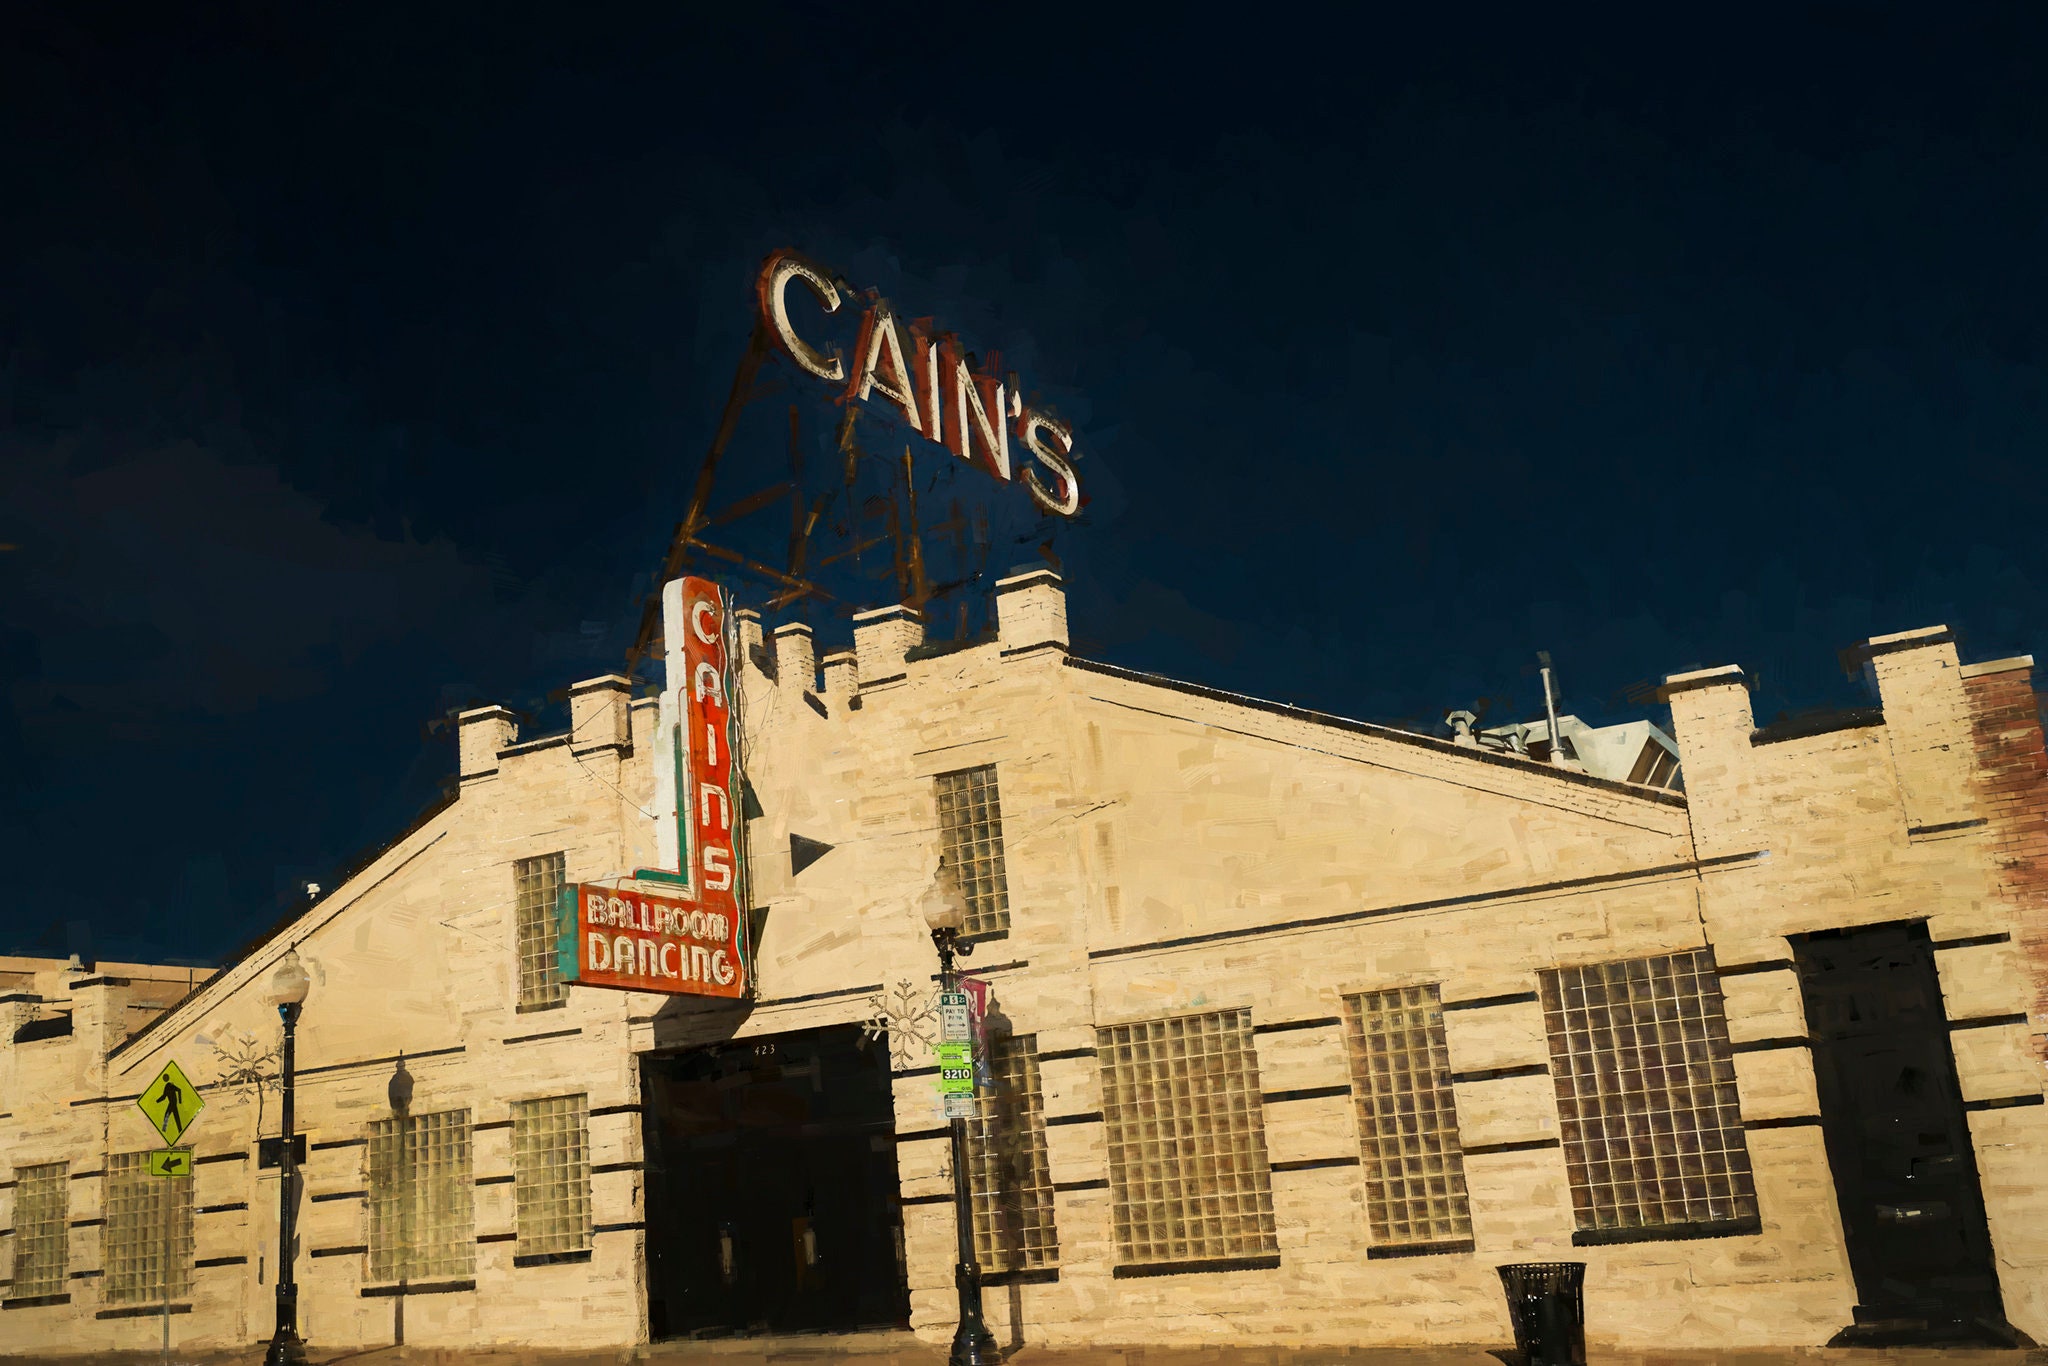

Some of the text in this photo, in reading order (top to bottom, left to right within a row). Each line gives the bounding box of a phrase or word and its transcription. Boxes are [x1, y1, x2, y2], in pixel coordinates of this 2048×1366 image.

[766, 256, 1079, 516] CAIN'S
[587, 893, 729, 942] BALLROOM
[588, 931, 735, 985] DANCING
[754, 1043, 775, 1056] 423
[944, 1069, 970, 1079] 3210
